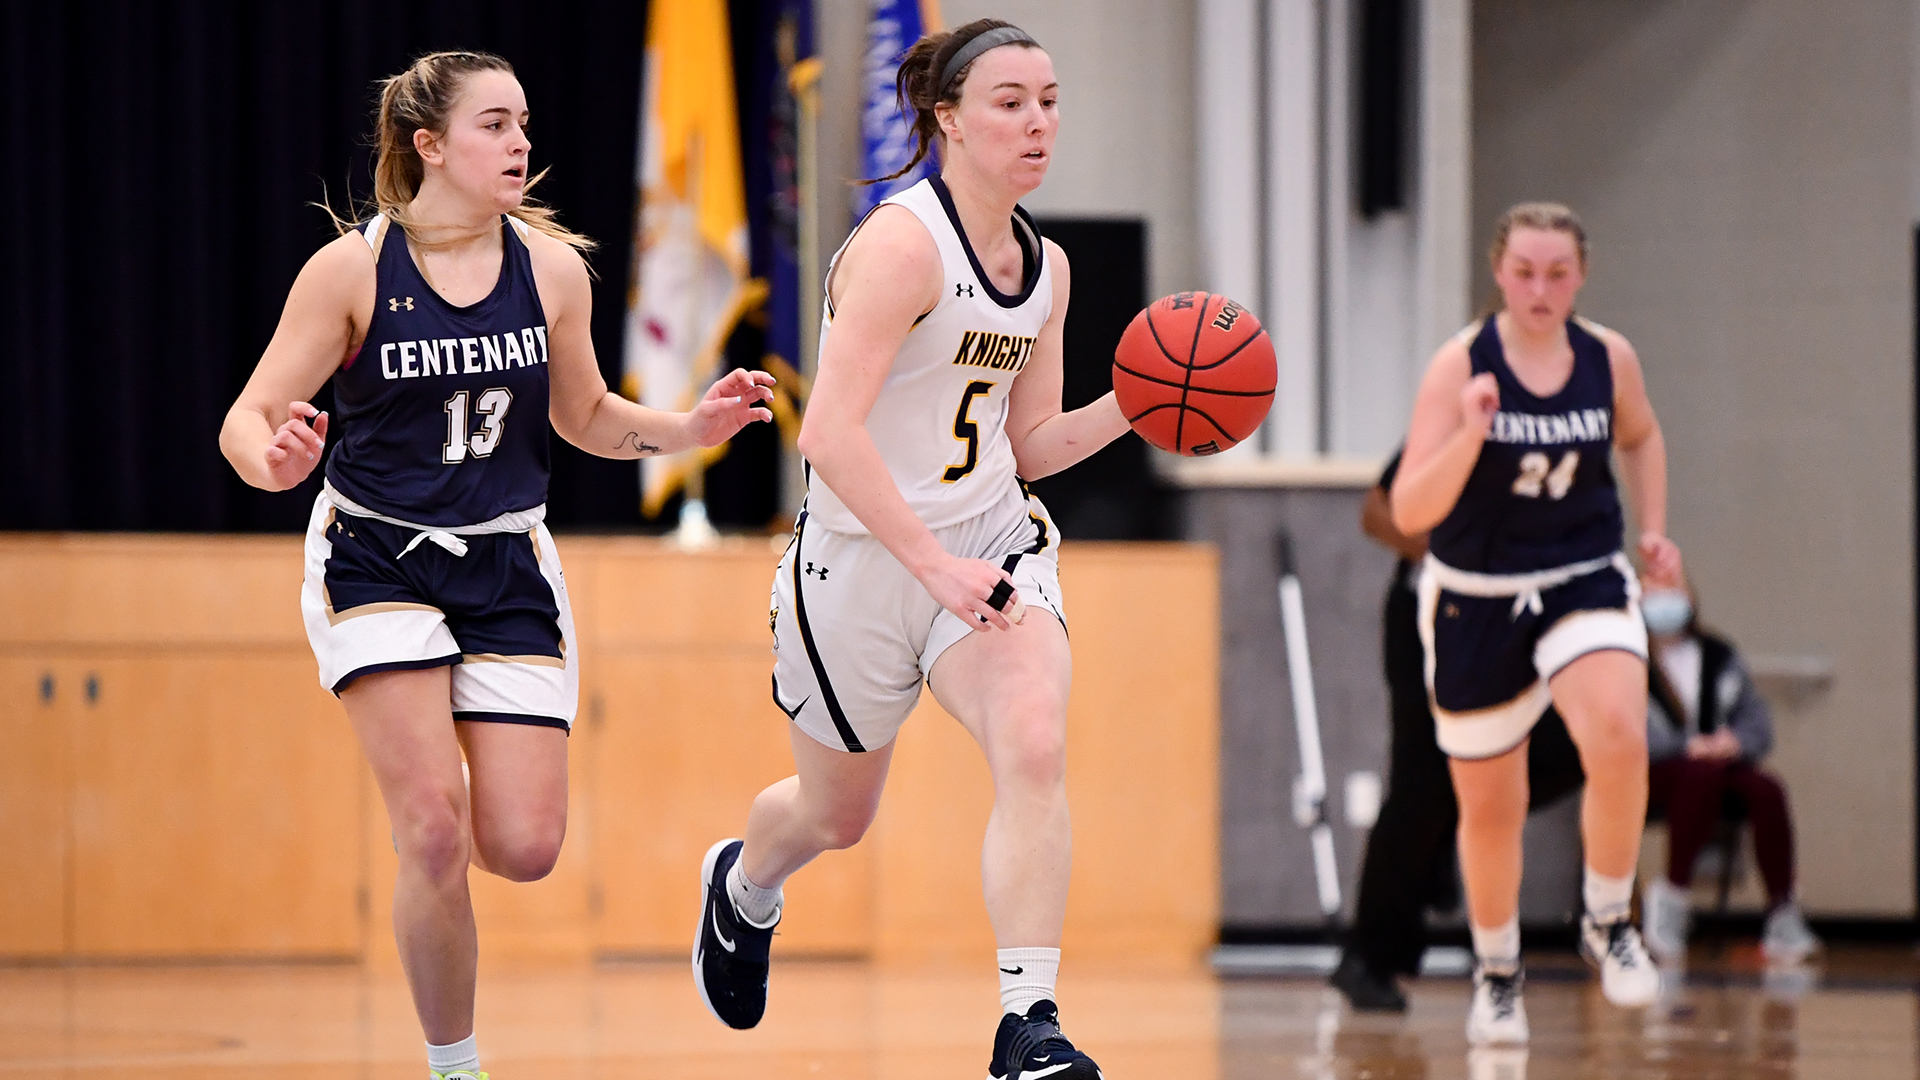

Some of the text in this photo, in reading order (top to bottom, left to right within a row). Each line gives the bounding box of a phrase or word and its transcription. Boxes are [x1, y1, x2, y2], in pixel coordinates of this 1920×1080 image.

[380, 325, 548, 380] CENTENARY
[952, 330, 1037, 372] KNIGHT
[442, 386, 514, 464] 13
[940, 379, 998, 483] 5
[1486, 408, 1610, 445] ENTENARY
[1511, 450, 1580, 501] 24
